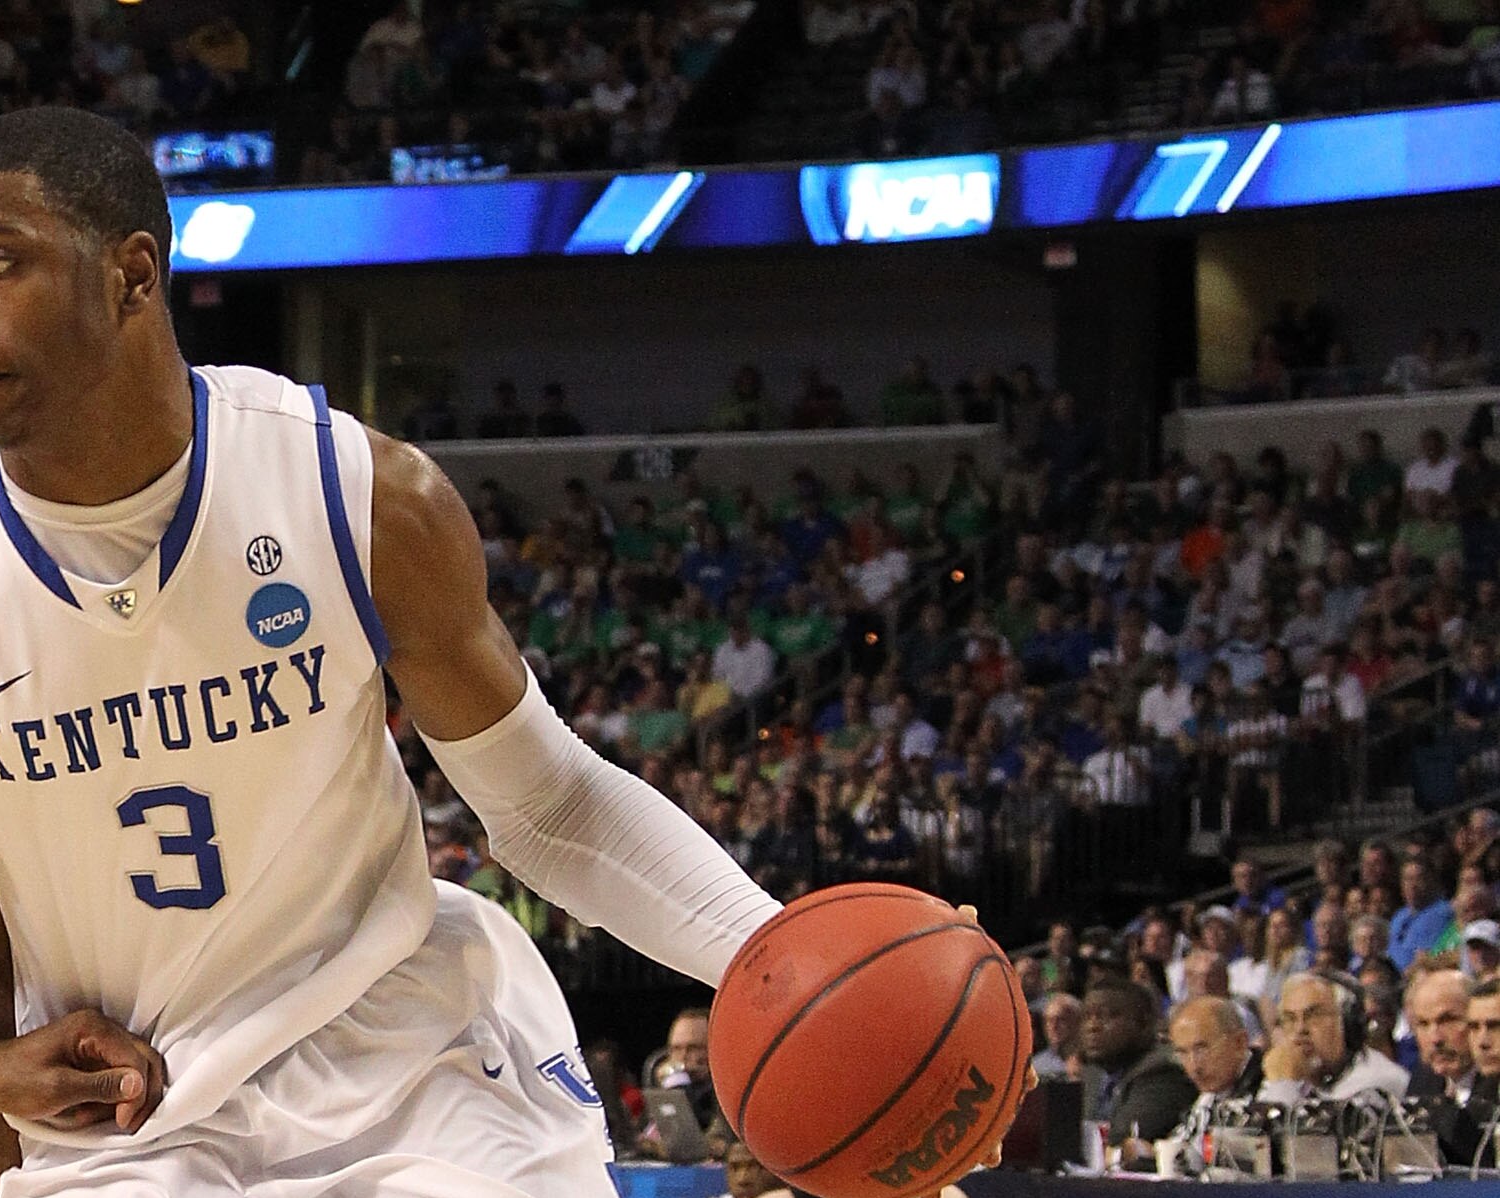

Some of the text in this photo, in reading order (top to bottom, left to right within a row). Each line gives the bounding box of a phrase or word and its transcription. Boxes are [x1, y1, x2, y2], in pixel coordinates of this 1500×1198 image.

[251, 538, 280, 574] SEC
[257, 607, 304, 635] NCAA
[116, 784, 227, 911] 3
[868, 1065, 995, 1188] NCAA
